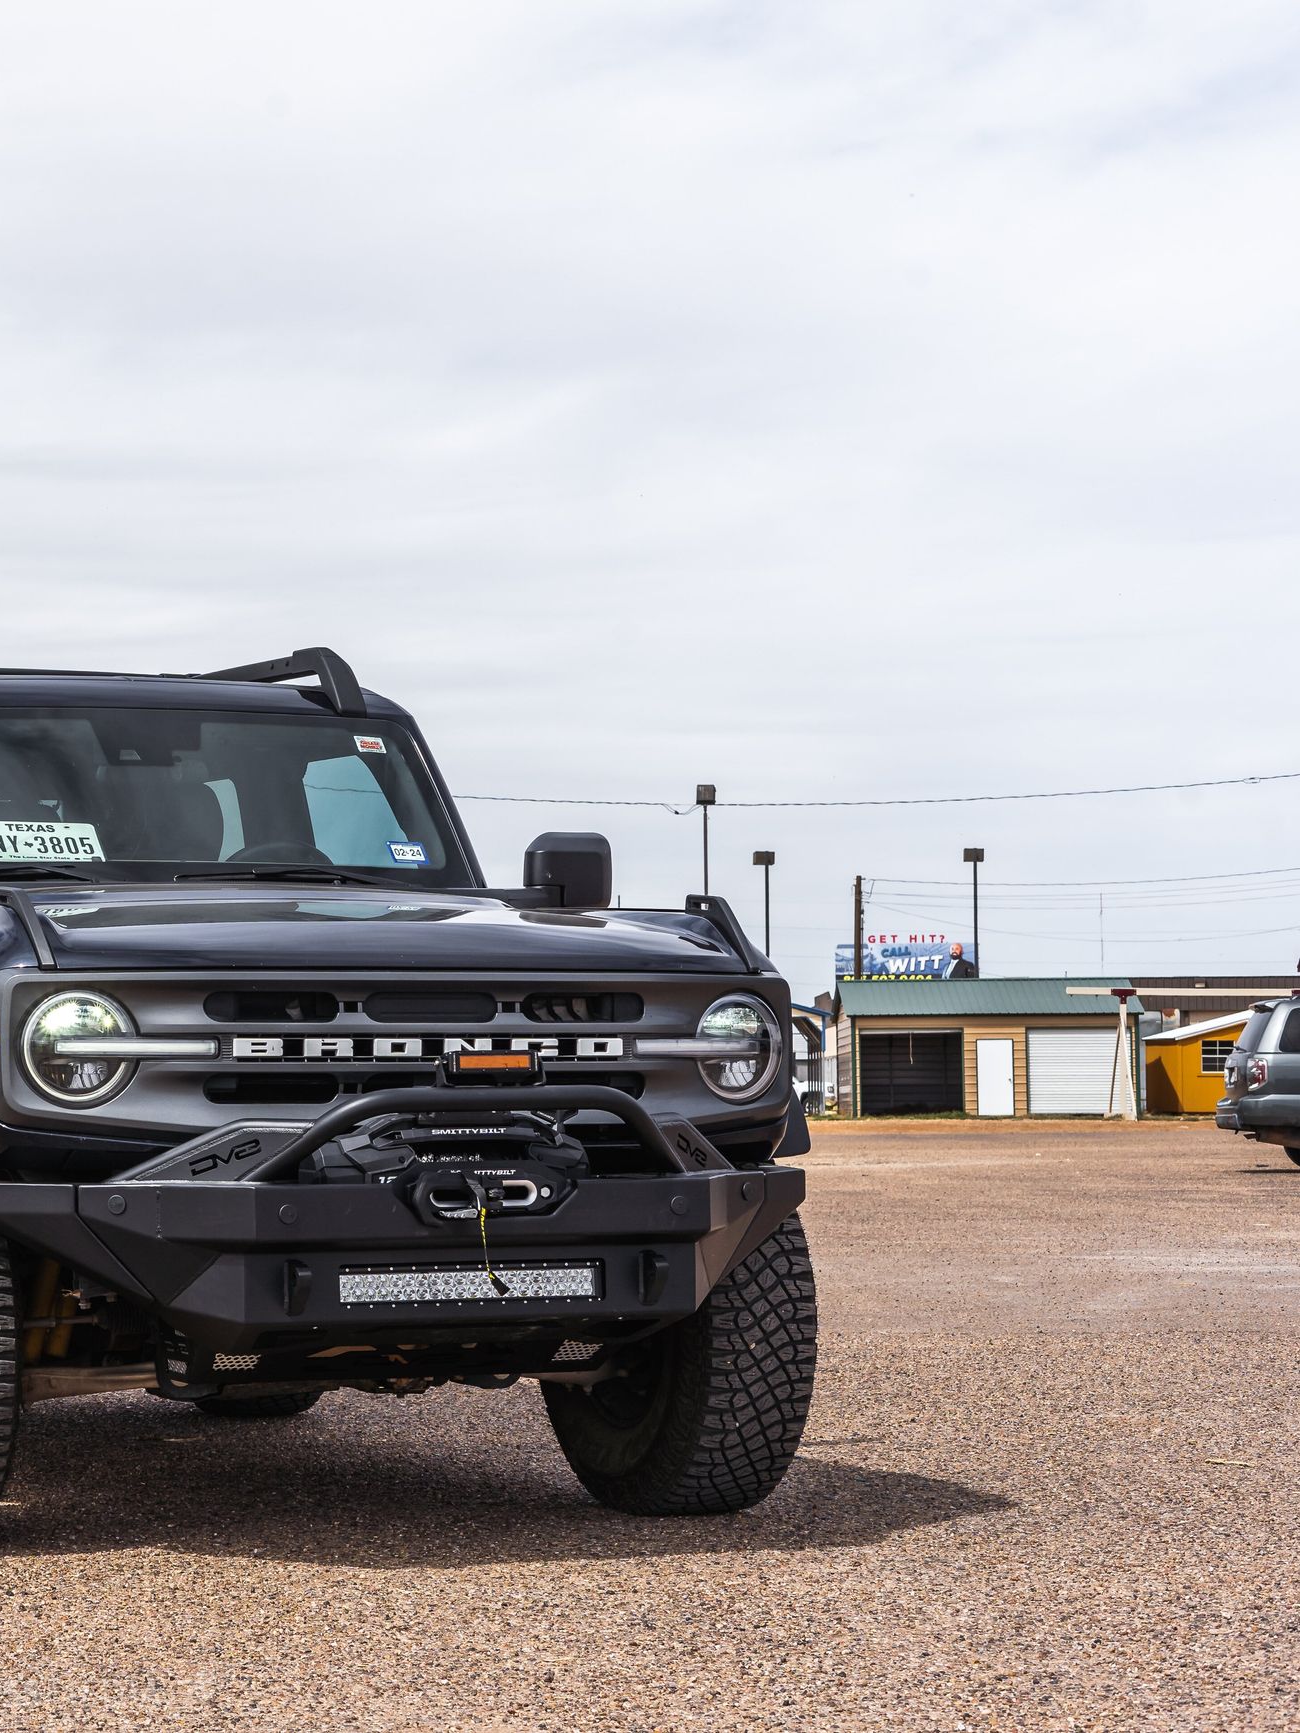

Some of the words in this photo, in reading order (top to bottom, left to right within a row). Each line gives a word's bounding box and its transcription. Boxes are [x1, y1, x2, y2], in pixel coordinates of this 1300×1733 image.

[4, 823, 56, 833] TEXAS
[867, 934, 898, 944] GET
[909, 934, 946, 944] HIT?
[880, 946, 912, 959] CALL
[887, 954, 944, 974] WITT
[232, 1037, 624, 1058] BRONCO
[431, 1127, 507, 1136] SMITTYBILT
